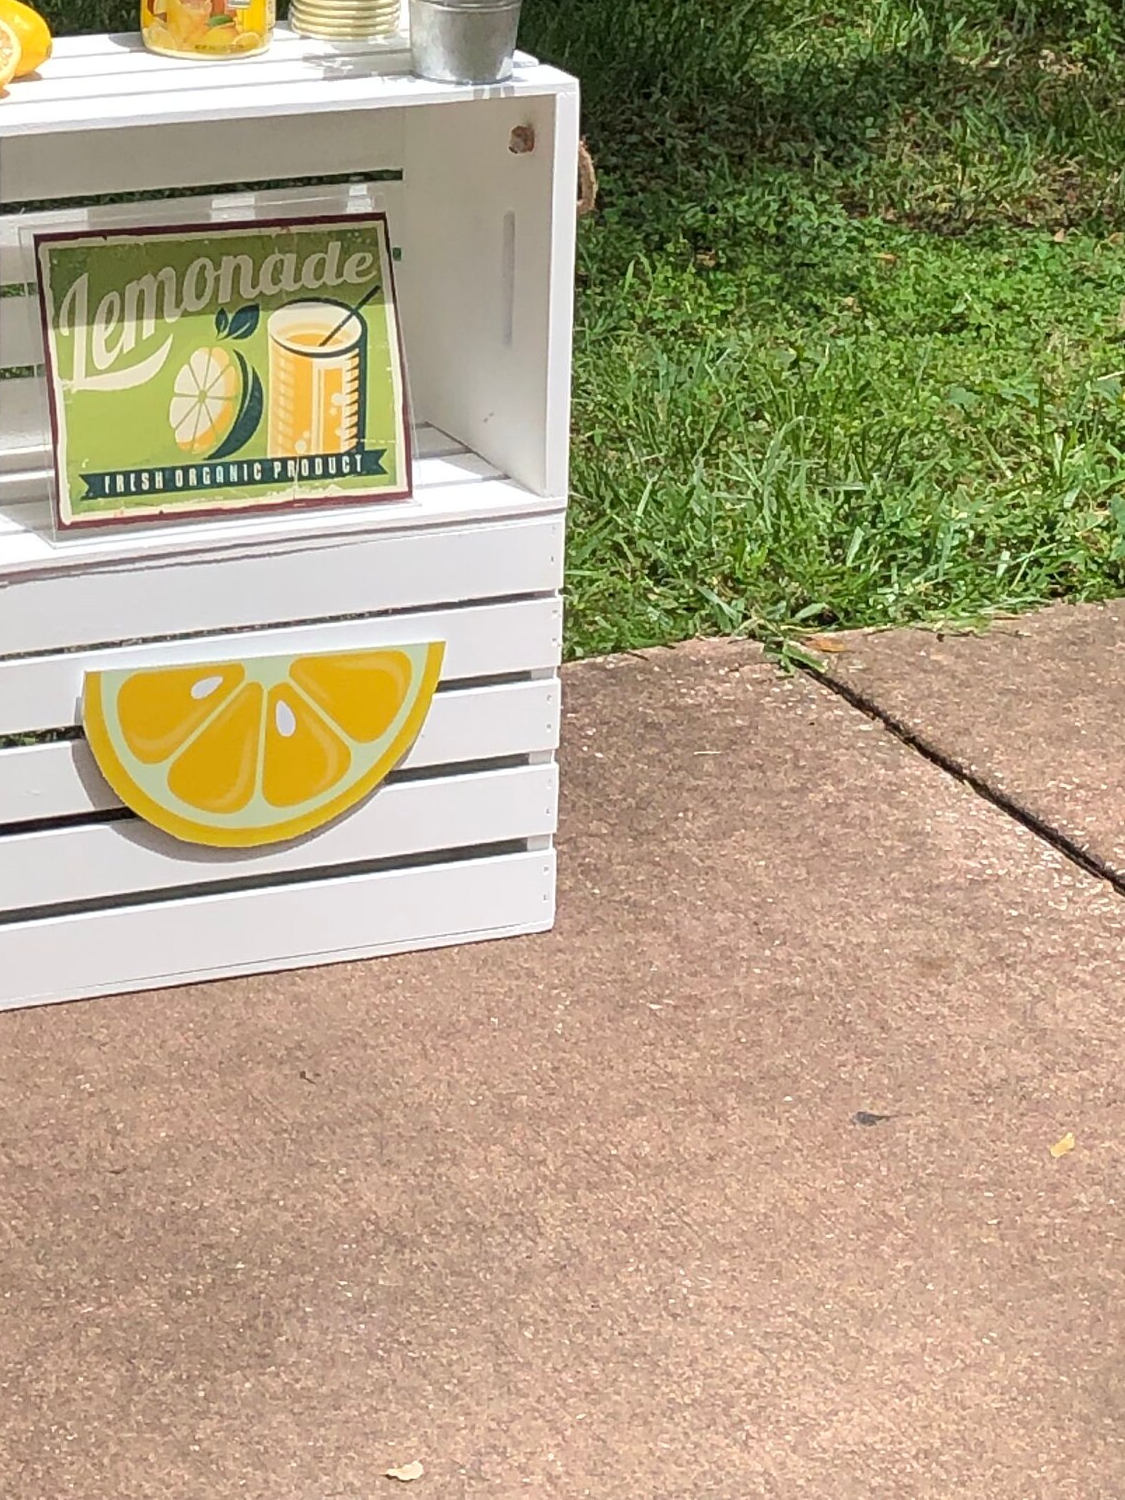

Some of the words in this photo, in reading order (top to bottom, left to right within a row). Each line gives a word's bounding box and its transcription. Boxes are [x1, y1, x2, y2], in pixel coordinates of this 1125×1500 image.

[59, 241, 378, 391] Lemonade
[104, 471, 164, 494] FRESH
[175, 461, 262, 488] ORGANIC
[273, 454, 362, 479] PRODUCT
